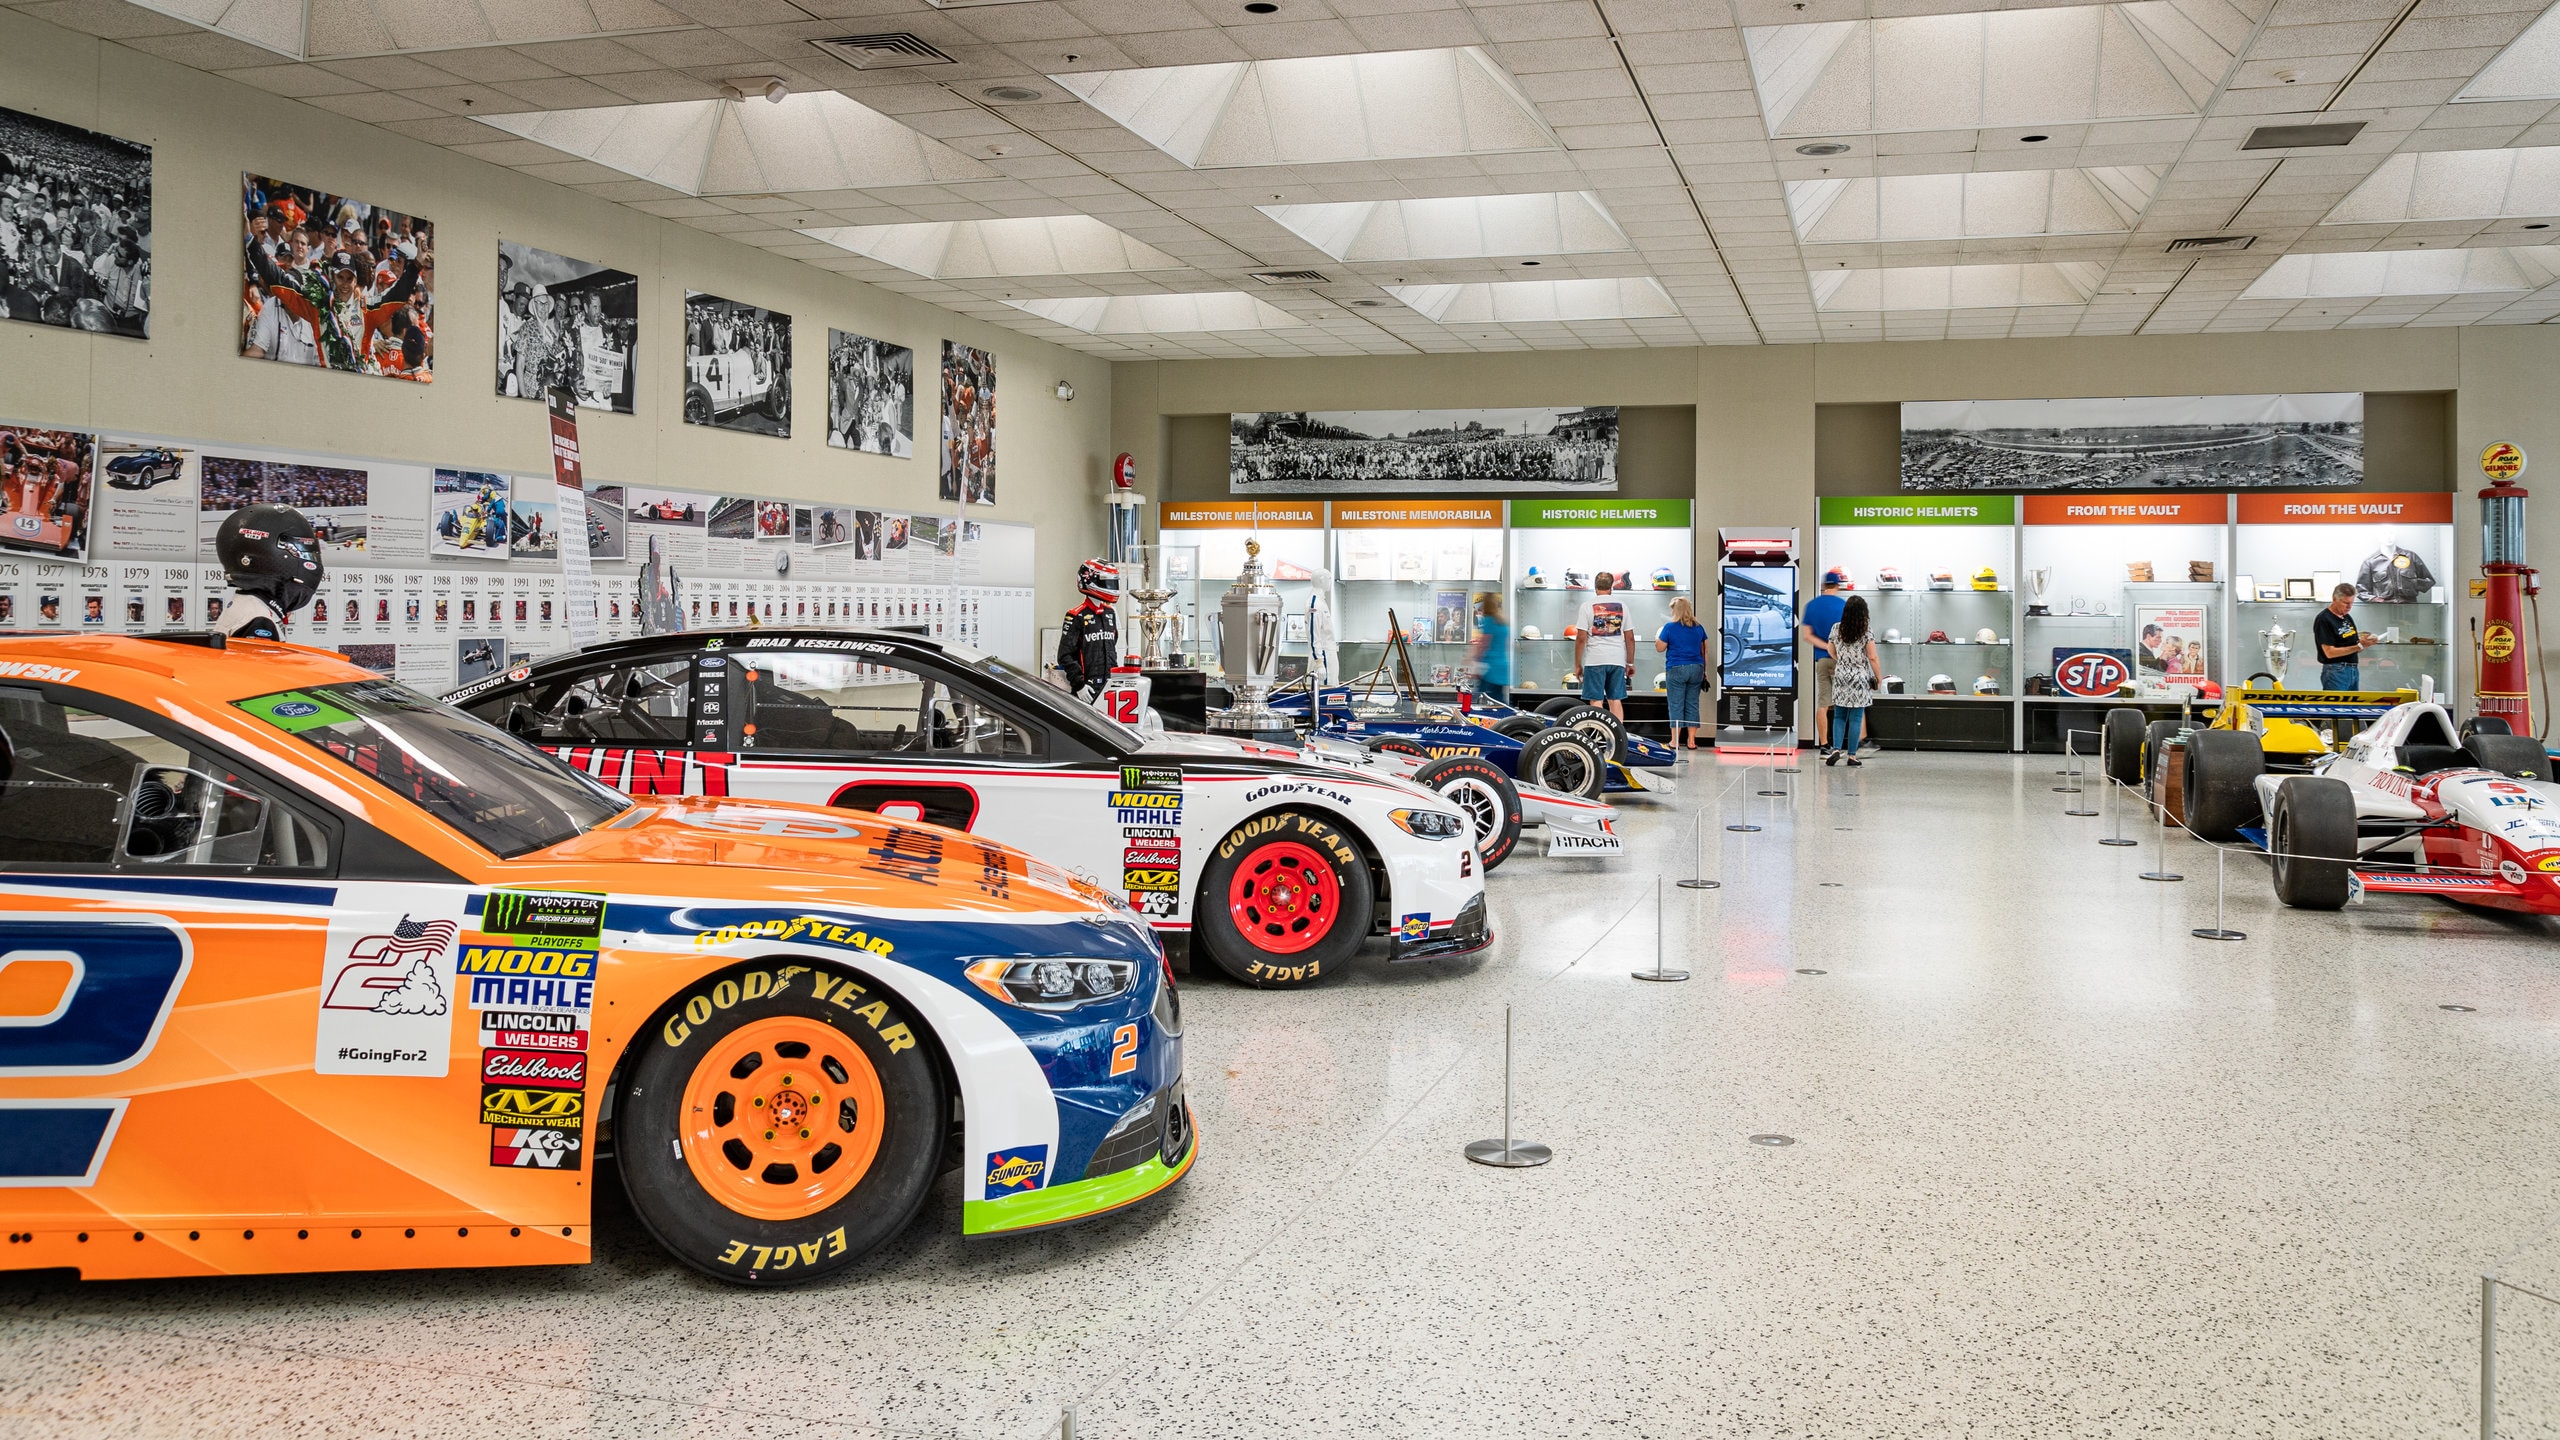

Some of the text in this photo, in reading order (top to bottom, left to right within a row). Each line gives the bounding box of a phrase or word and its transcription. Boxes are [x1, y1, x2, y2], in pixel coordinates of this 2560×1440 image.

[2485, 464, 2519, 472] GILMORE
[1341, 510, 1492, 520] MILESTONE MEMORABILIA
[1542, 509, 1657, 519] HISTORIC HELMETS
[1854, 507, 1979, 517] HISTORIC HELMETS
[2067, 505, 2181, 516] FROM THE VAULT
[2284, 504, 2404, 515] FROM THE VAULT
[1170, 511, 1314, 521] MILESTONE MEMORABILIA
[20, 518, 35, 529] 14
[37, 564, 64, 577] 1977
[81, 566, 108, 579] 1978
[124, 567, 149, 580] 1979
[164, 568, 189, 580] 1980
[343, 573, 363, 584] 1985
[374, 573, 394, 585] 1986
[404, 574, 423, 586] 1987
[433, 575, 451, 587] 1988
[461, 575, 478, 586] 1989
[487, 577, 504, 588] 1990
[513, 577, 529, 587] 1991
[538, 577, 555, 588] 1992
[2486, 619, 2514, 629] STADIUM
[1085, 629, 1115, 642] verizon
[746, 638, 896, 655] BRAD KESELOWSKI
[0, 661, 80, 683] WSKI
[2066, 658, 2118, 689] STP
[442, 675, 506, 703] Autotrader
[2242, 693, 2365, 703] PENNZOIL
[1104, 690, 1139, 724] 12
[1426, 747, 1481, 760] NOCO
[1435, 765, 1504, 784] Firestone
[1110, 793, 1181, 808] MOOG
[1117, 809, 1182, 825] MAHLE
[1125, 828, 1171, 838] LINCOLN
[1135, 839, 1176, 847] WELDERS
[1556, 836, 1619, 848] HITACHI
[1125, 851, 1178, 866] Edelbrock
[1460, 850, 1472, 878] 2
[1124, 882, 1178, 892] MECHANIX WEAR
[530, 897, 599, 909] MONSTER
[535, 914, 595, 924] NASCAR CUP SERIES
[1403, 922, 1427, 932] SUNOCO
[530, 937, 584, 948] PLAYOFFS
[460, 948, 594, 977] MOOG
[1246, 960, 1320, 981] EAGLE
[472, 977, 593, 1009] MAHLE
[556, 1007, 590, 1015] BEARINGS
[486, 1013, 571, 1032] LINCOLN
[505, 1032, 578, 1048] WELDERS
[338, 1047, 427, 1063] #GoingFor2
[1109, 1023, 1138, 1078] 2
[485, 1055, 582, 1082] Edelbrock
[483, 1111, 580, 1128] MECHANIX WEAR
[990, 1163, 1041, 1183] SUNOCO
[717, 1225, 847, 1270] EAGLE
